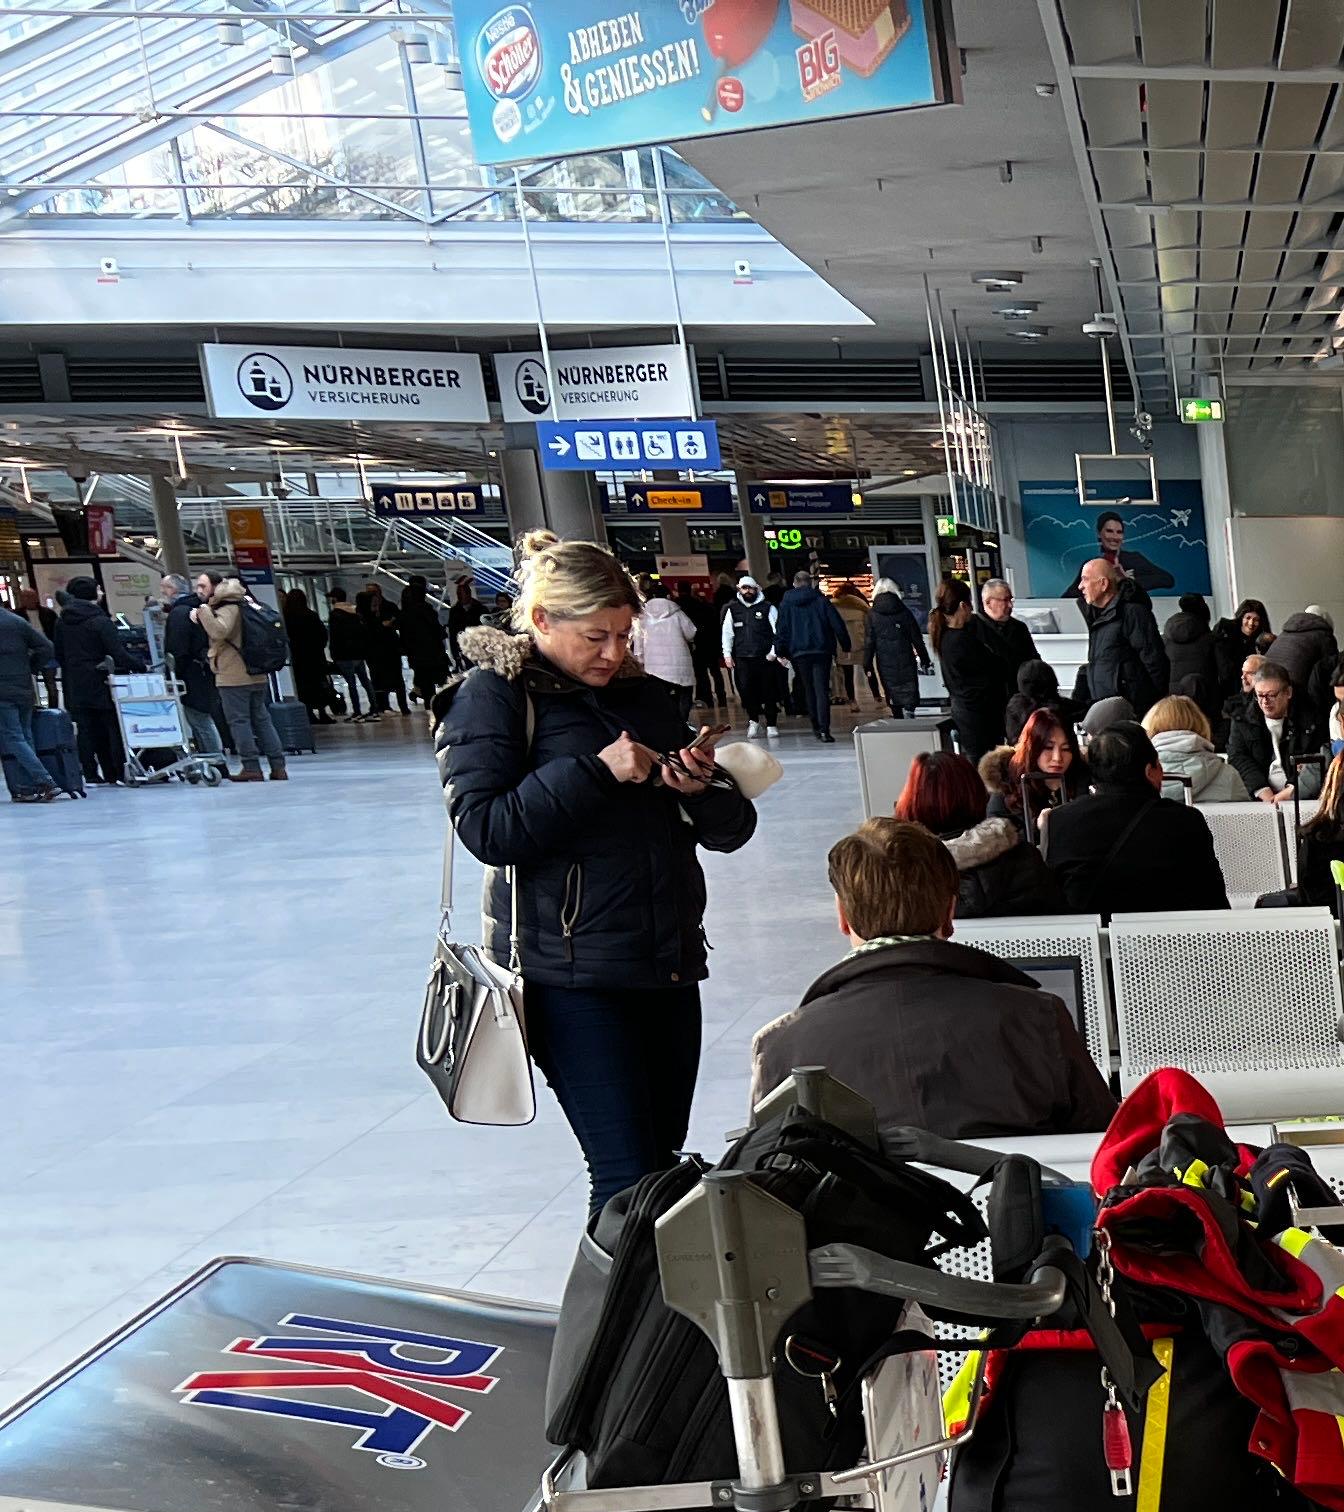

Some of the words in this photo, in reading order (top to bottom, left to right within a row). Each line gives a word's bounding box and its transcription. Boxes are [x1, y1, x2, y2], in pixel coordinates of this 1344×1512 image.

[567, 11, 645, 64] ABHEBEN
[796, 28, 841, 90] BIG
[303, 363, 462, 390] NÜRNBERGER
[556, 362, 670, 387] NÜRNBERGER
[307, 389, 421, 406] VERSICHERUNG
[560, 389, 640, 405] VERSICHERUNG
[650, 495, 692, 505] Check-in
[777, 529, 802, 543] GO
[172, 1312, 506, 1458] RKT
